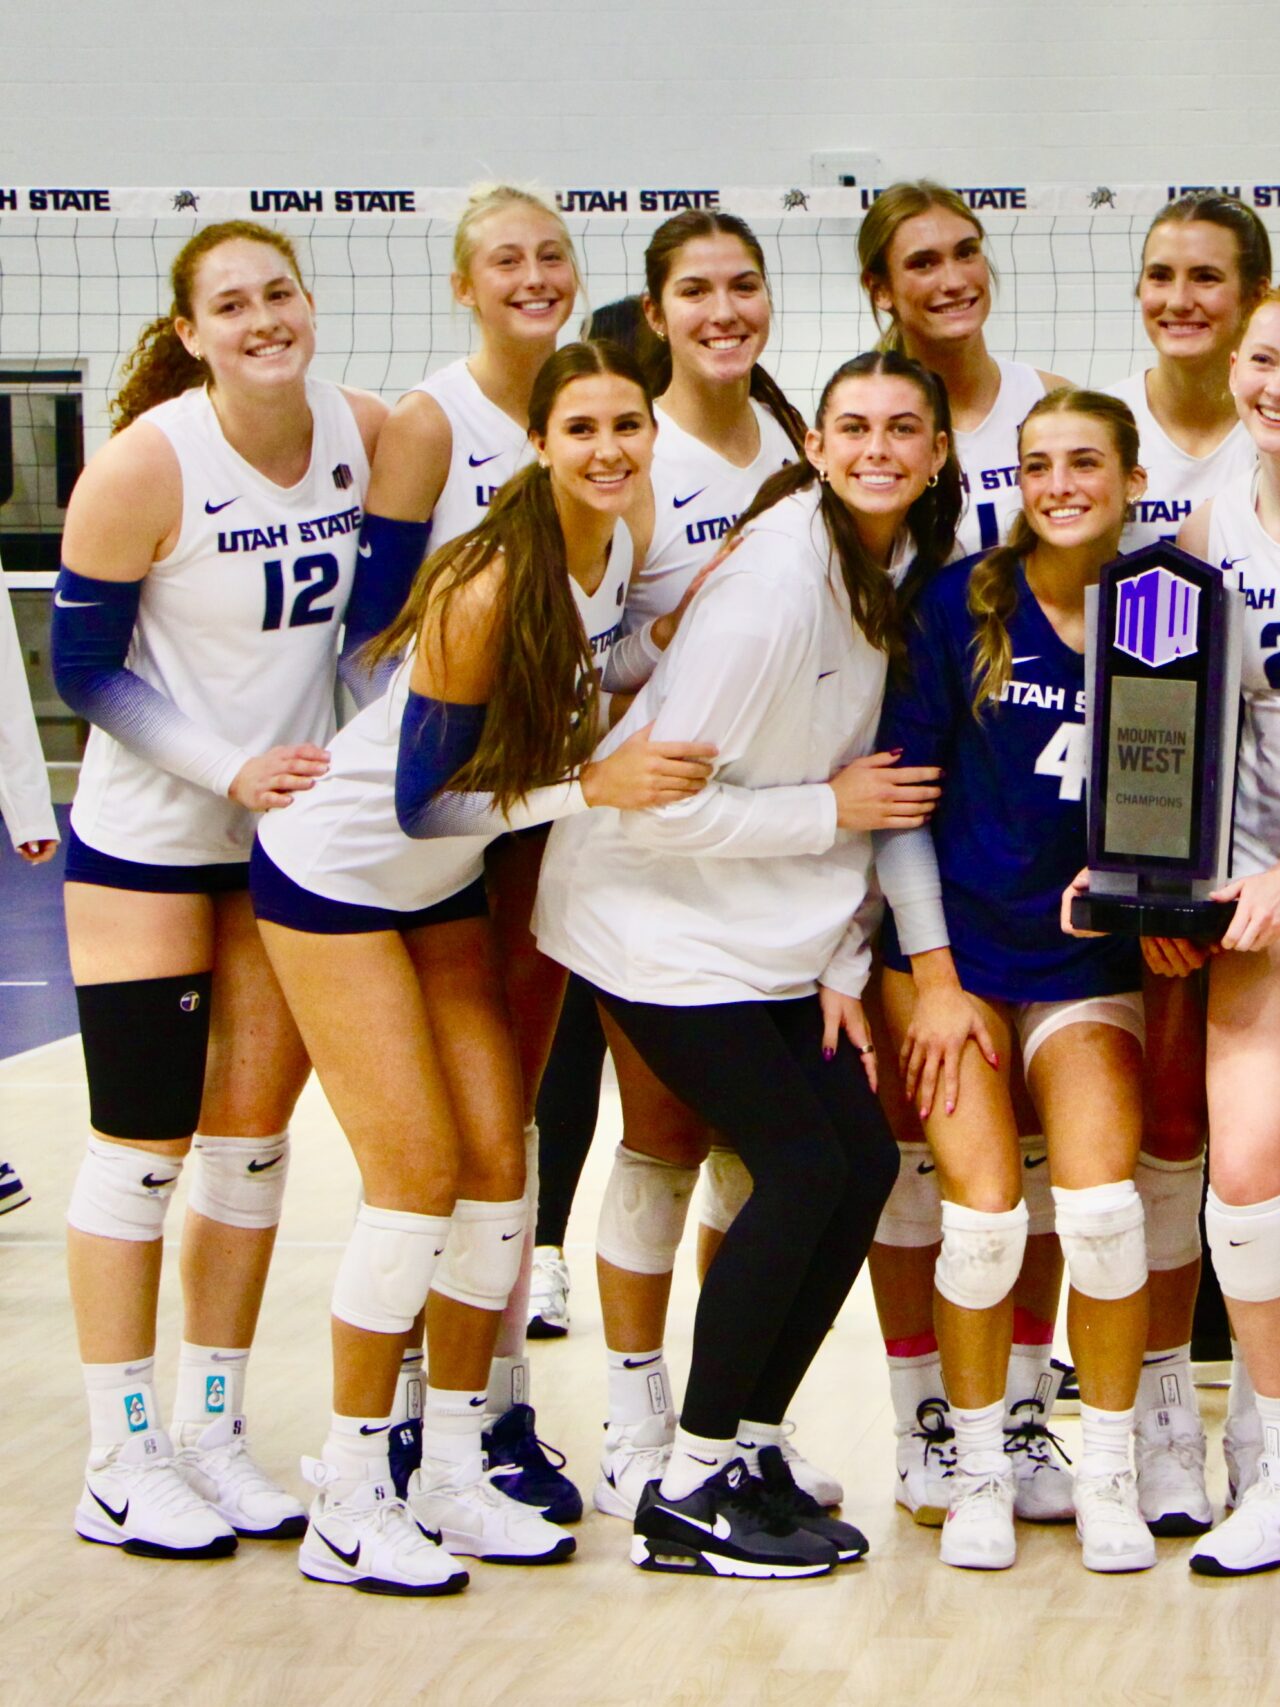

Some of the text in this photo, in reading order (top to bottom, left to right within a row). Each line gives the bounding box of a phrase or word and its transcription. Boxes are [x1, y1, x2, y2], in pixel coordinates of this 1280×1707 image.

[29, 189, 111, 212] STATE
[250, 190, 415, 213] UTAH STATE
[555, 190, 720, 212] UTAH STATE
[950, 187, 1027, 209] TATE
[217, 505, 362, 553] UTAH STATE
[261, 552, 340, 632] 12
[1117, 727, 1187, 746] MOUNTAIN
[1034, 721, 1087, 802] 4
[1117, 744, 1186, 775] WEST
[1115, 792, 1184, 810] CHAMPIONS
